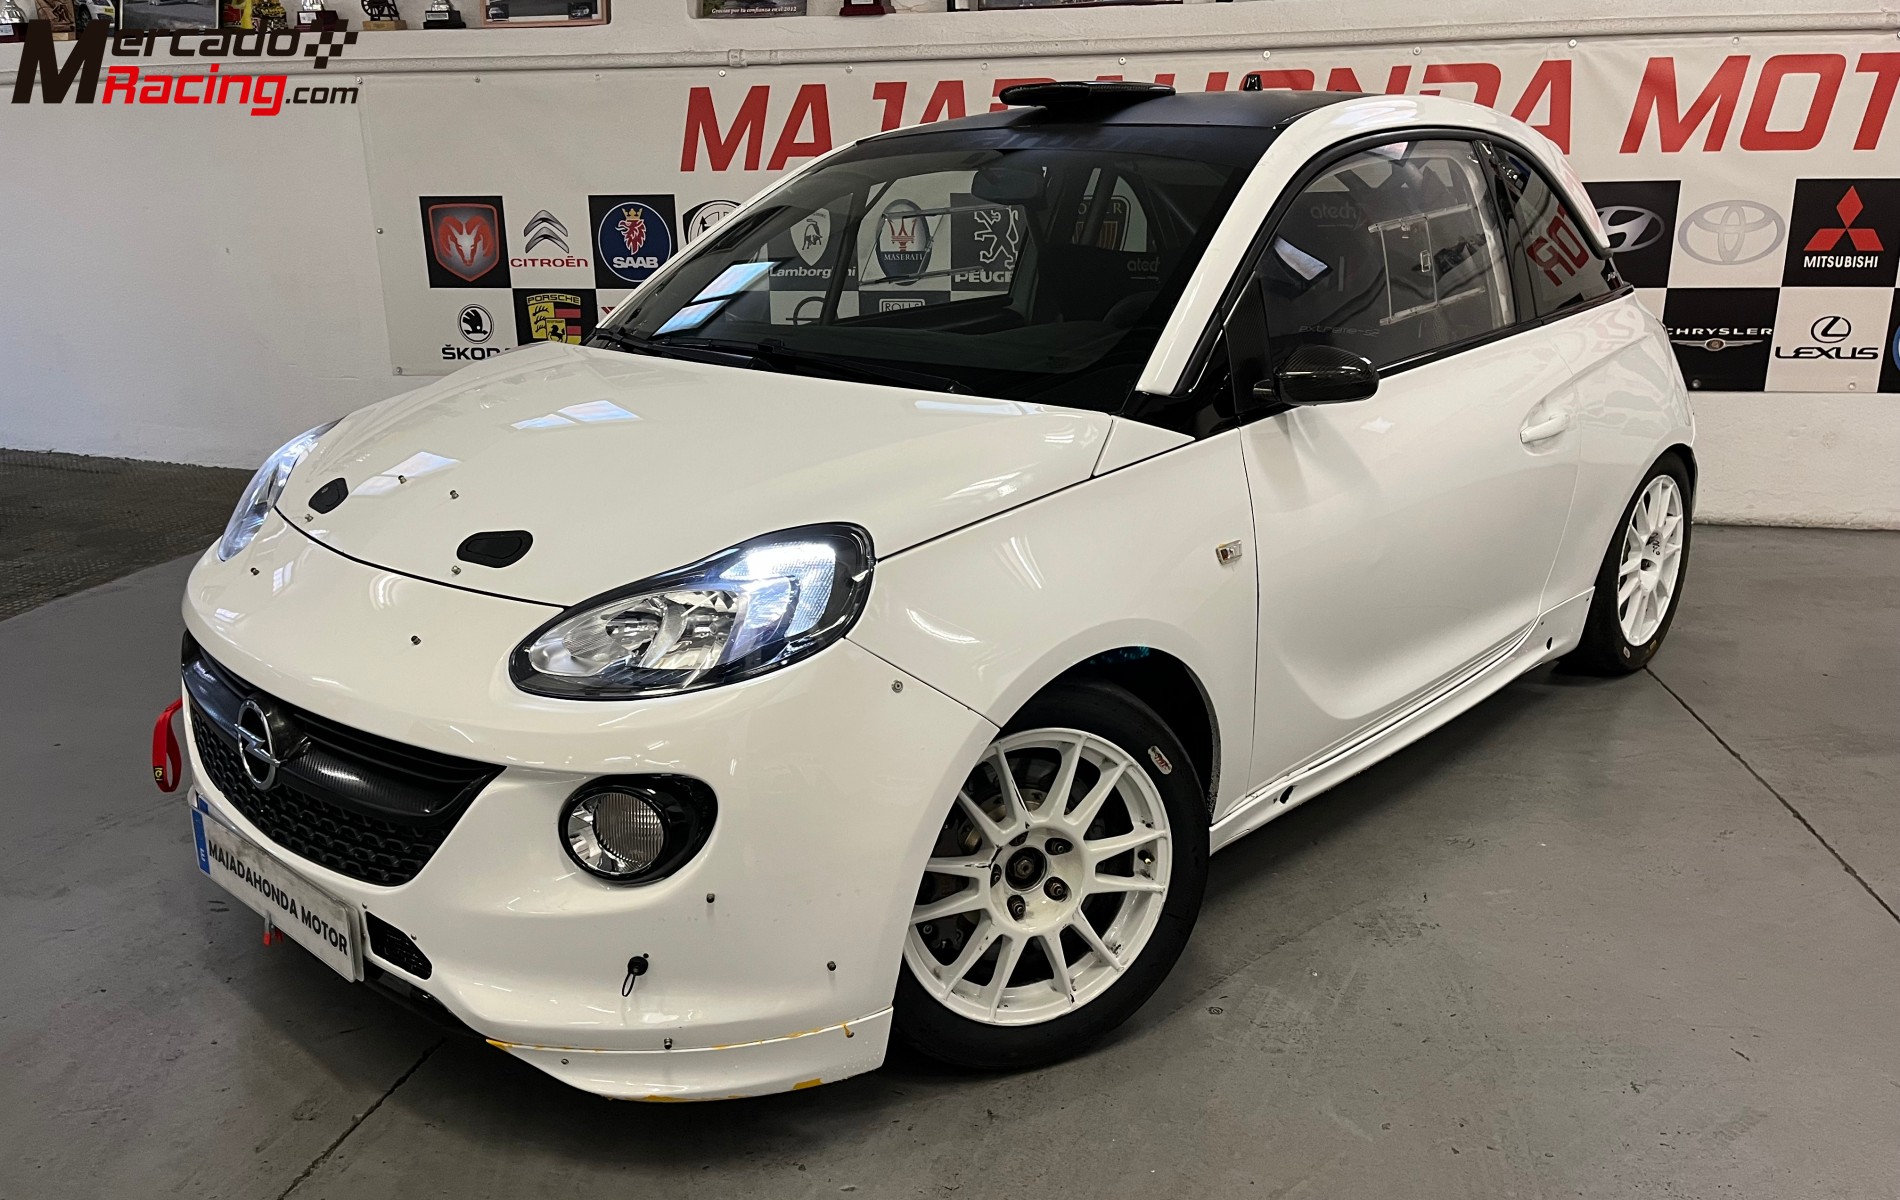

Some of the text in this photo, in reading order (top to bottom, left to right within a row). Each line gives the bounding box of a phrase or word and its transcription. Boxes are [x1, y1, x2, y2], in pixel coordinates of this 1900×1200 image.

[510, 255, 589, 268] CITROËN
[612, 255, 660, 269] SAAB
[883, 252, 924, 262] MASERATI
[1803, 255, 1879, 269] MITSUBISHI
[527, 294, 580, 304] PORSCHE
[441, 344, 511, 361] ŠKOD
[1774, 346, 1879, 360] LEXUS
[208, 839, 348, 956] MAJADAHONDA MOTOR
